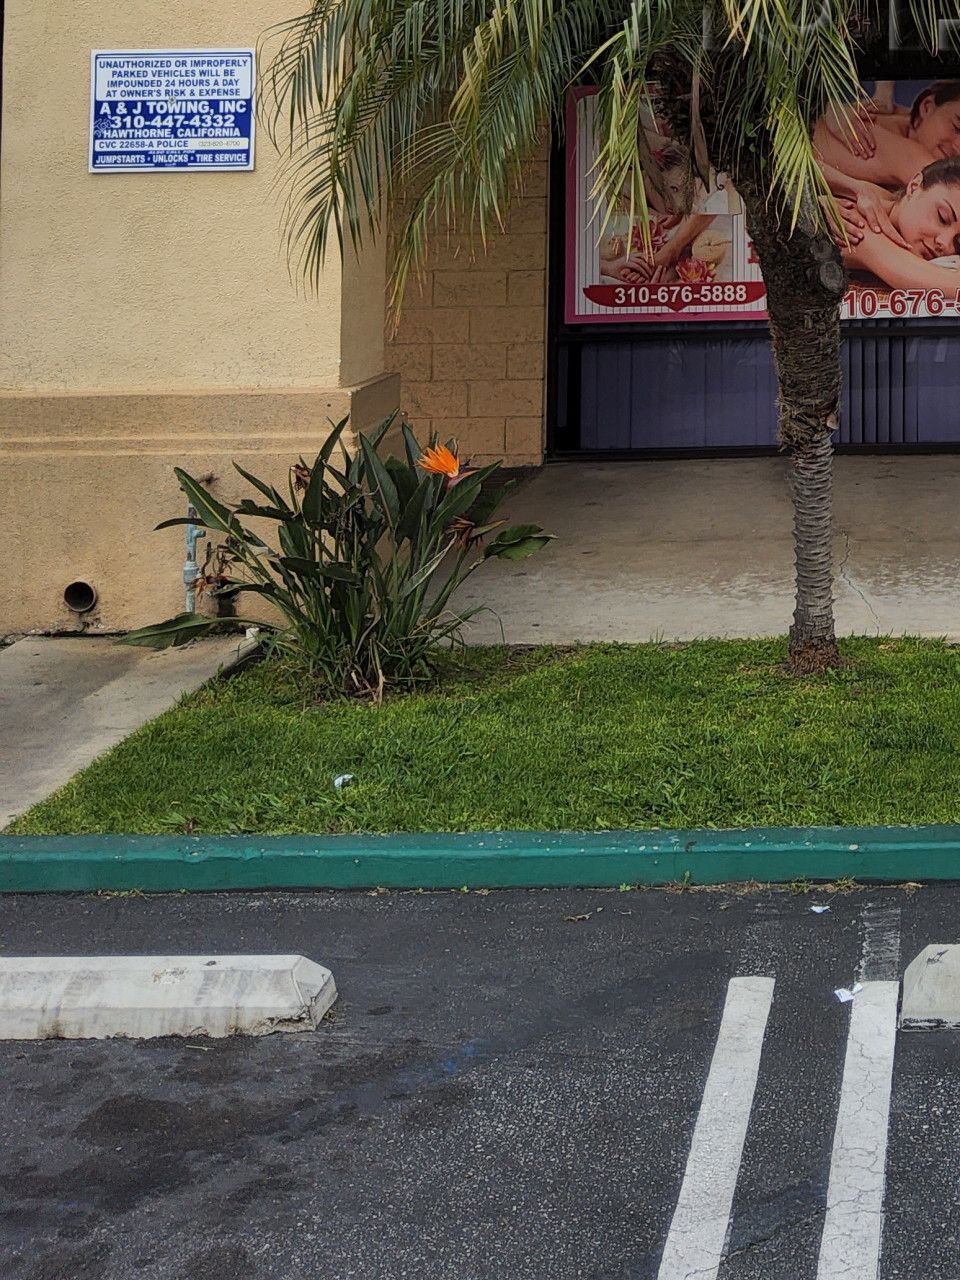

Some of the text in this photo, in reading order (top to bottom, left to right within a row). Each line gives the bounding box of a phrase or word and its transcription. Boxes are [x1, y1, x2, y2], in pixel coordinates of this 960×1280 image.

[99, 59, 248, 69] UNAUTHORIZED OR IMPROPERLY
[111, 69, 235, 78] PARKED VEHICLES WILL BE
[107, 80, 162, 88] IMPOUNDED
[178, 79, 210, 87] HOURS
[222, 78, 240, 87] DAY
[120, 89, 161, 97] OWNER'S
[165, 89, 186, 97] RISK
[199, 88, 240, 96] EXPENSE
[101, 100, 247, 115] A & J TOWING, INC
[110, 115, 235, 128] 310-447-4332
[103, 128, 240, 139] HAWTHORNE, CALIFORNIA
[99, 141, 116, 149] CVC
[157, 140, 188, 148] POLICE
[96, 153, 247, 163] JUMPSTARTS UNLOCKS TIRE SERVICE
[614, 284, 747, 304] 310-676-5888
